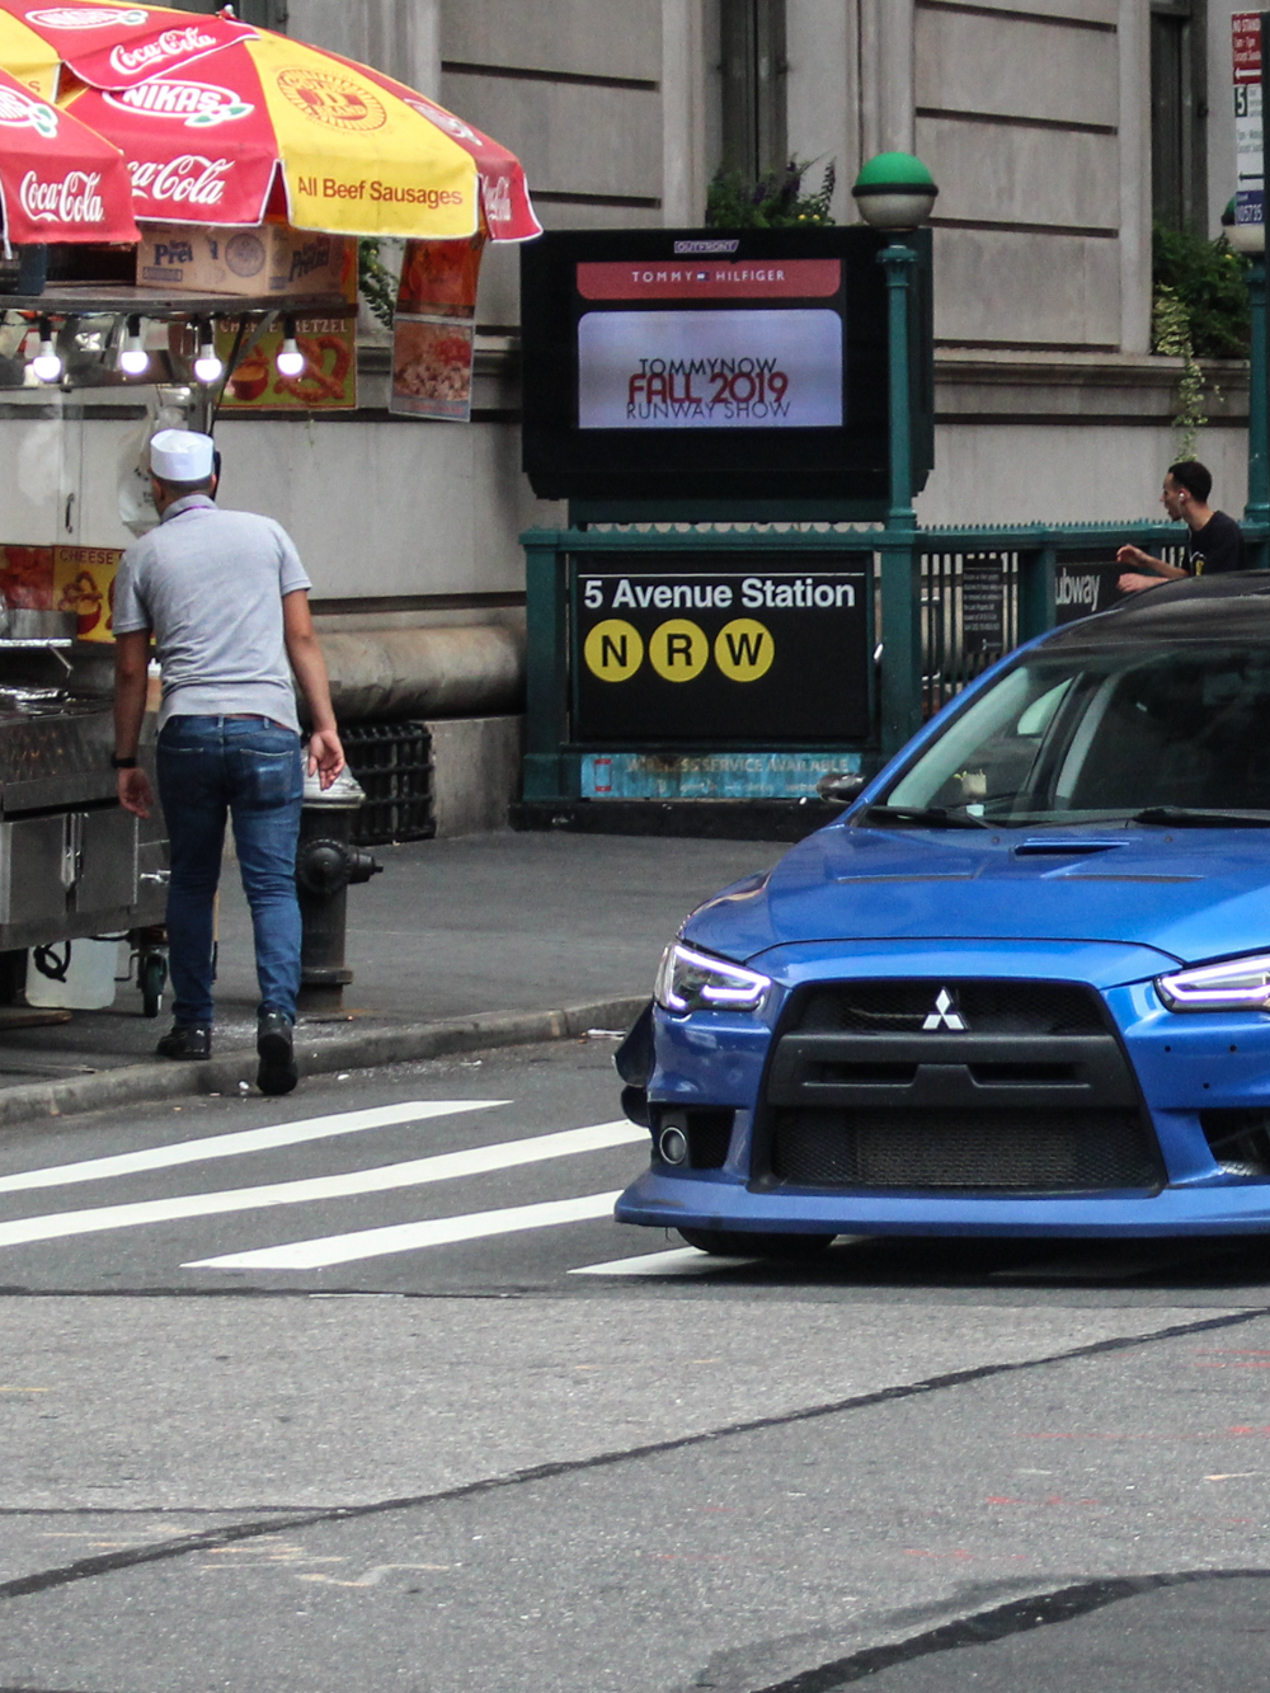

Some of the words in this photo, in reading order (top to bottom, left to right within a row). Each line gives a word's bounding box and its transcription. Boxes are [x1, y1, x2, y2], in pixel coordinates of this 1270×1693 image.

[1242, 18, 1262, 32] STAND
[110, 27, 216, 75] Coca-Cola
[123, 86, 222, 112] NIKAS
[127, 155, 236, 205] ca-Cola
[298, 176, 317, 197] All
[323, 178, 366, 199] Beef
[370, 181, 463, 209] Sausages
[20, 170, 105, 222] Coca-Cola
[631, 271, 694, 282] TOMMY
[715, 270, 786, 282] HILFIGER
[295, 318, 348, 333] ETZEL
[638, 357, 777, 376] TOMMYNOW
[628, 372, 703, 405] FALL
[709, 371, 789, 404] 2019
[626, 401, 717, 420] RUNWAY
[724, 401, 791, 418] SHOW
[60, 550, 114, 565] CHEESE
[584, 580, 603, 609] 5
[612, 579, 733, 608] Avenue
[741, 578, 856, 608] Station
[1055, 567, 1101, 612] ubway
[601, 634, 628, 668] N
[666, 633, 693, 666] R
[725, 632, 764, 666] W
[702, 757, 764, 772] SERVICE
[766, 757, 849, 772] AVAILABLE
